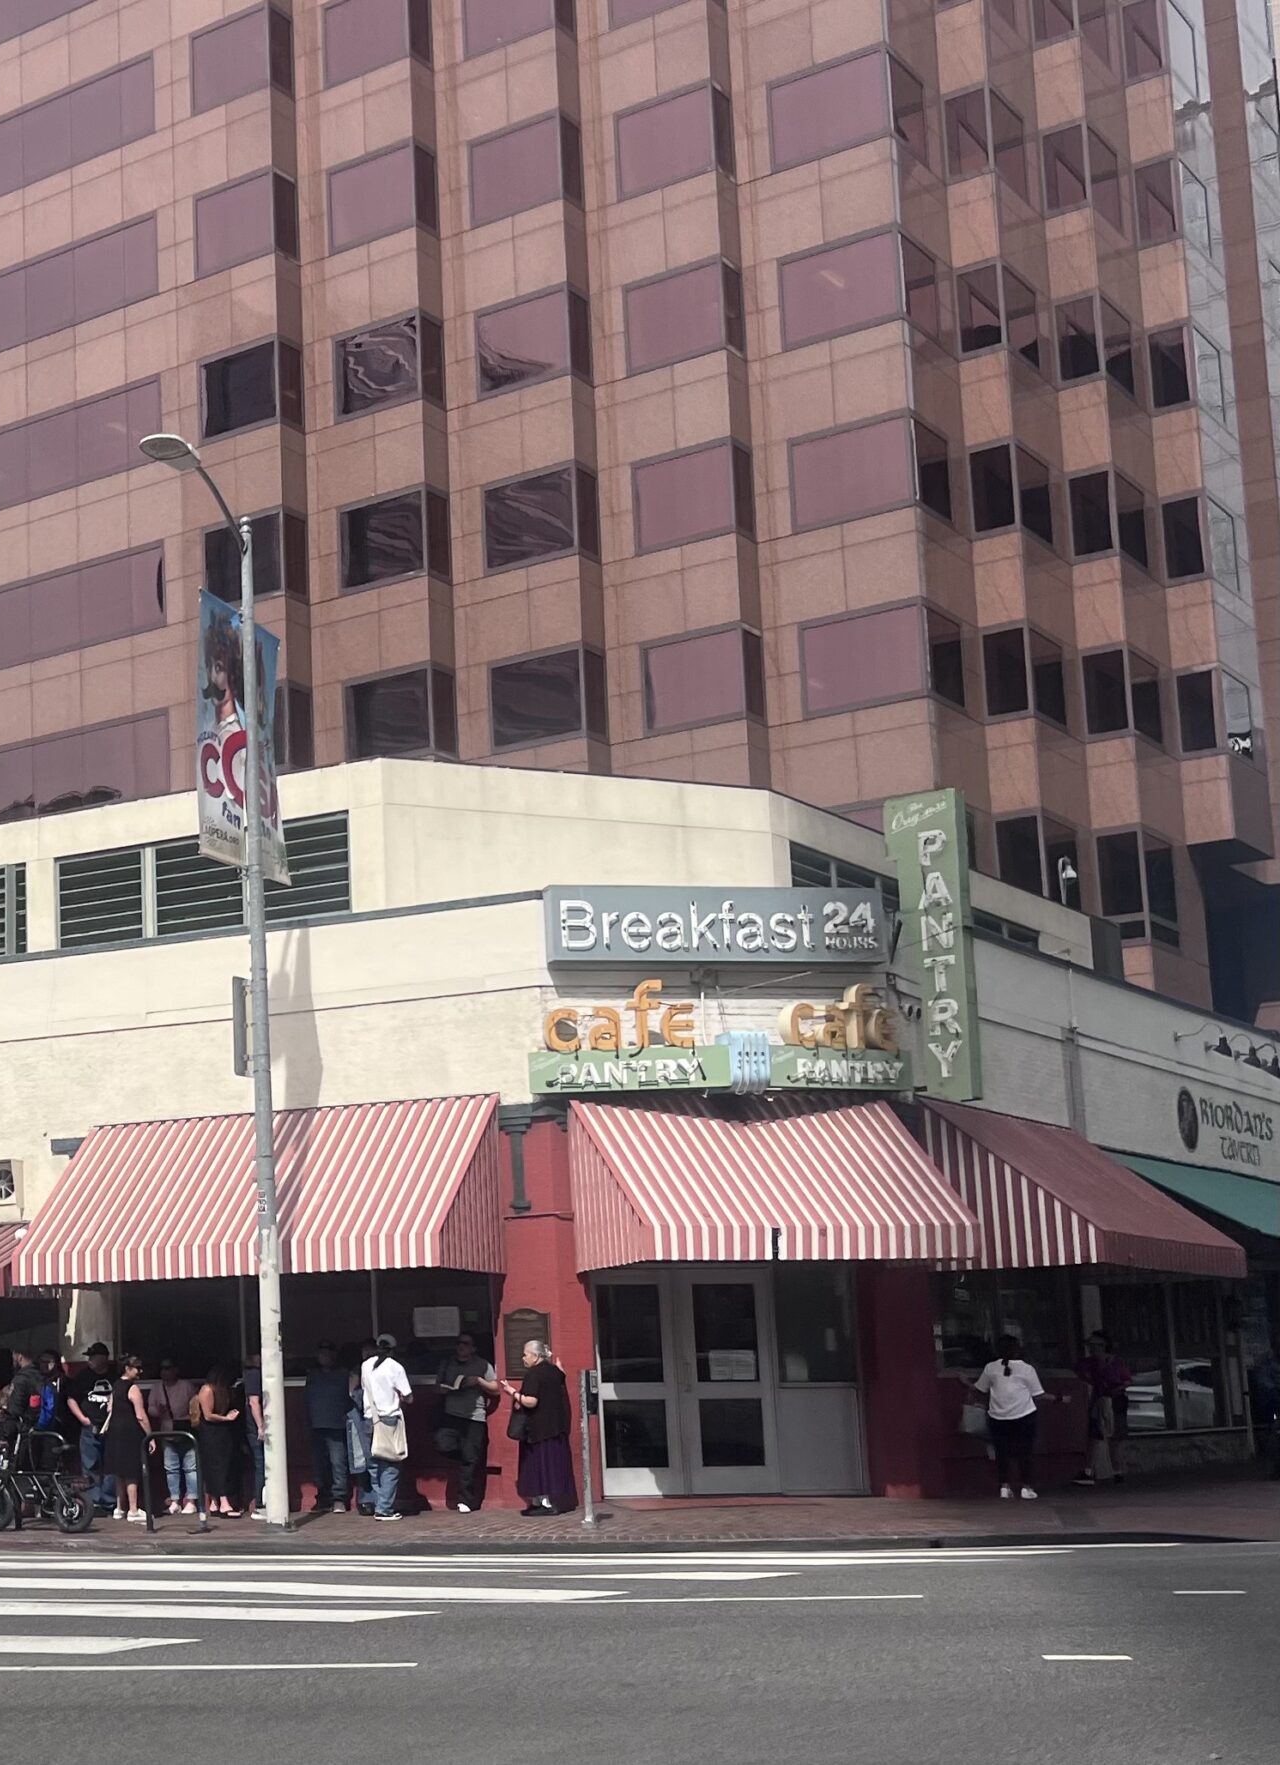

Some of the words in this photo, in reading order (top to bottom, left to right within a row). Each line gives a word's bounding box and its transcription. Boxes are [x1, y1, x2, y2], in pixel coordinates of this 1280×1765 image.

[222, 801, 241, 831] fan
[559, 899, 814, 951] Breakfast
[823, 901, 877, 935] 24
[825, 936, 879, 949] HOURS
[917, 829, 963, 1078] PANTRY
[558, 1058, 704, 1089] PANTRY
[796, 1058, 904, 1088] PANTRY
